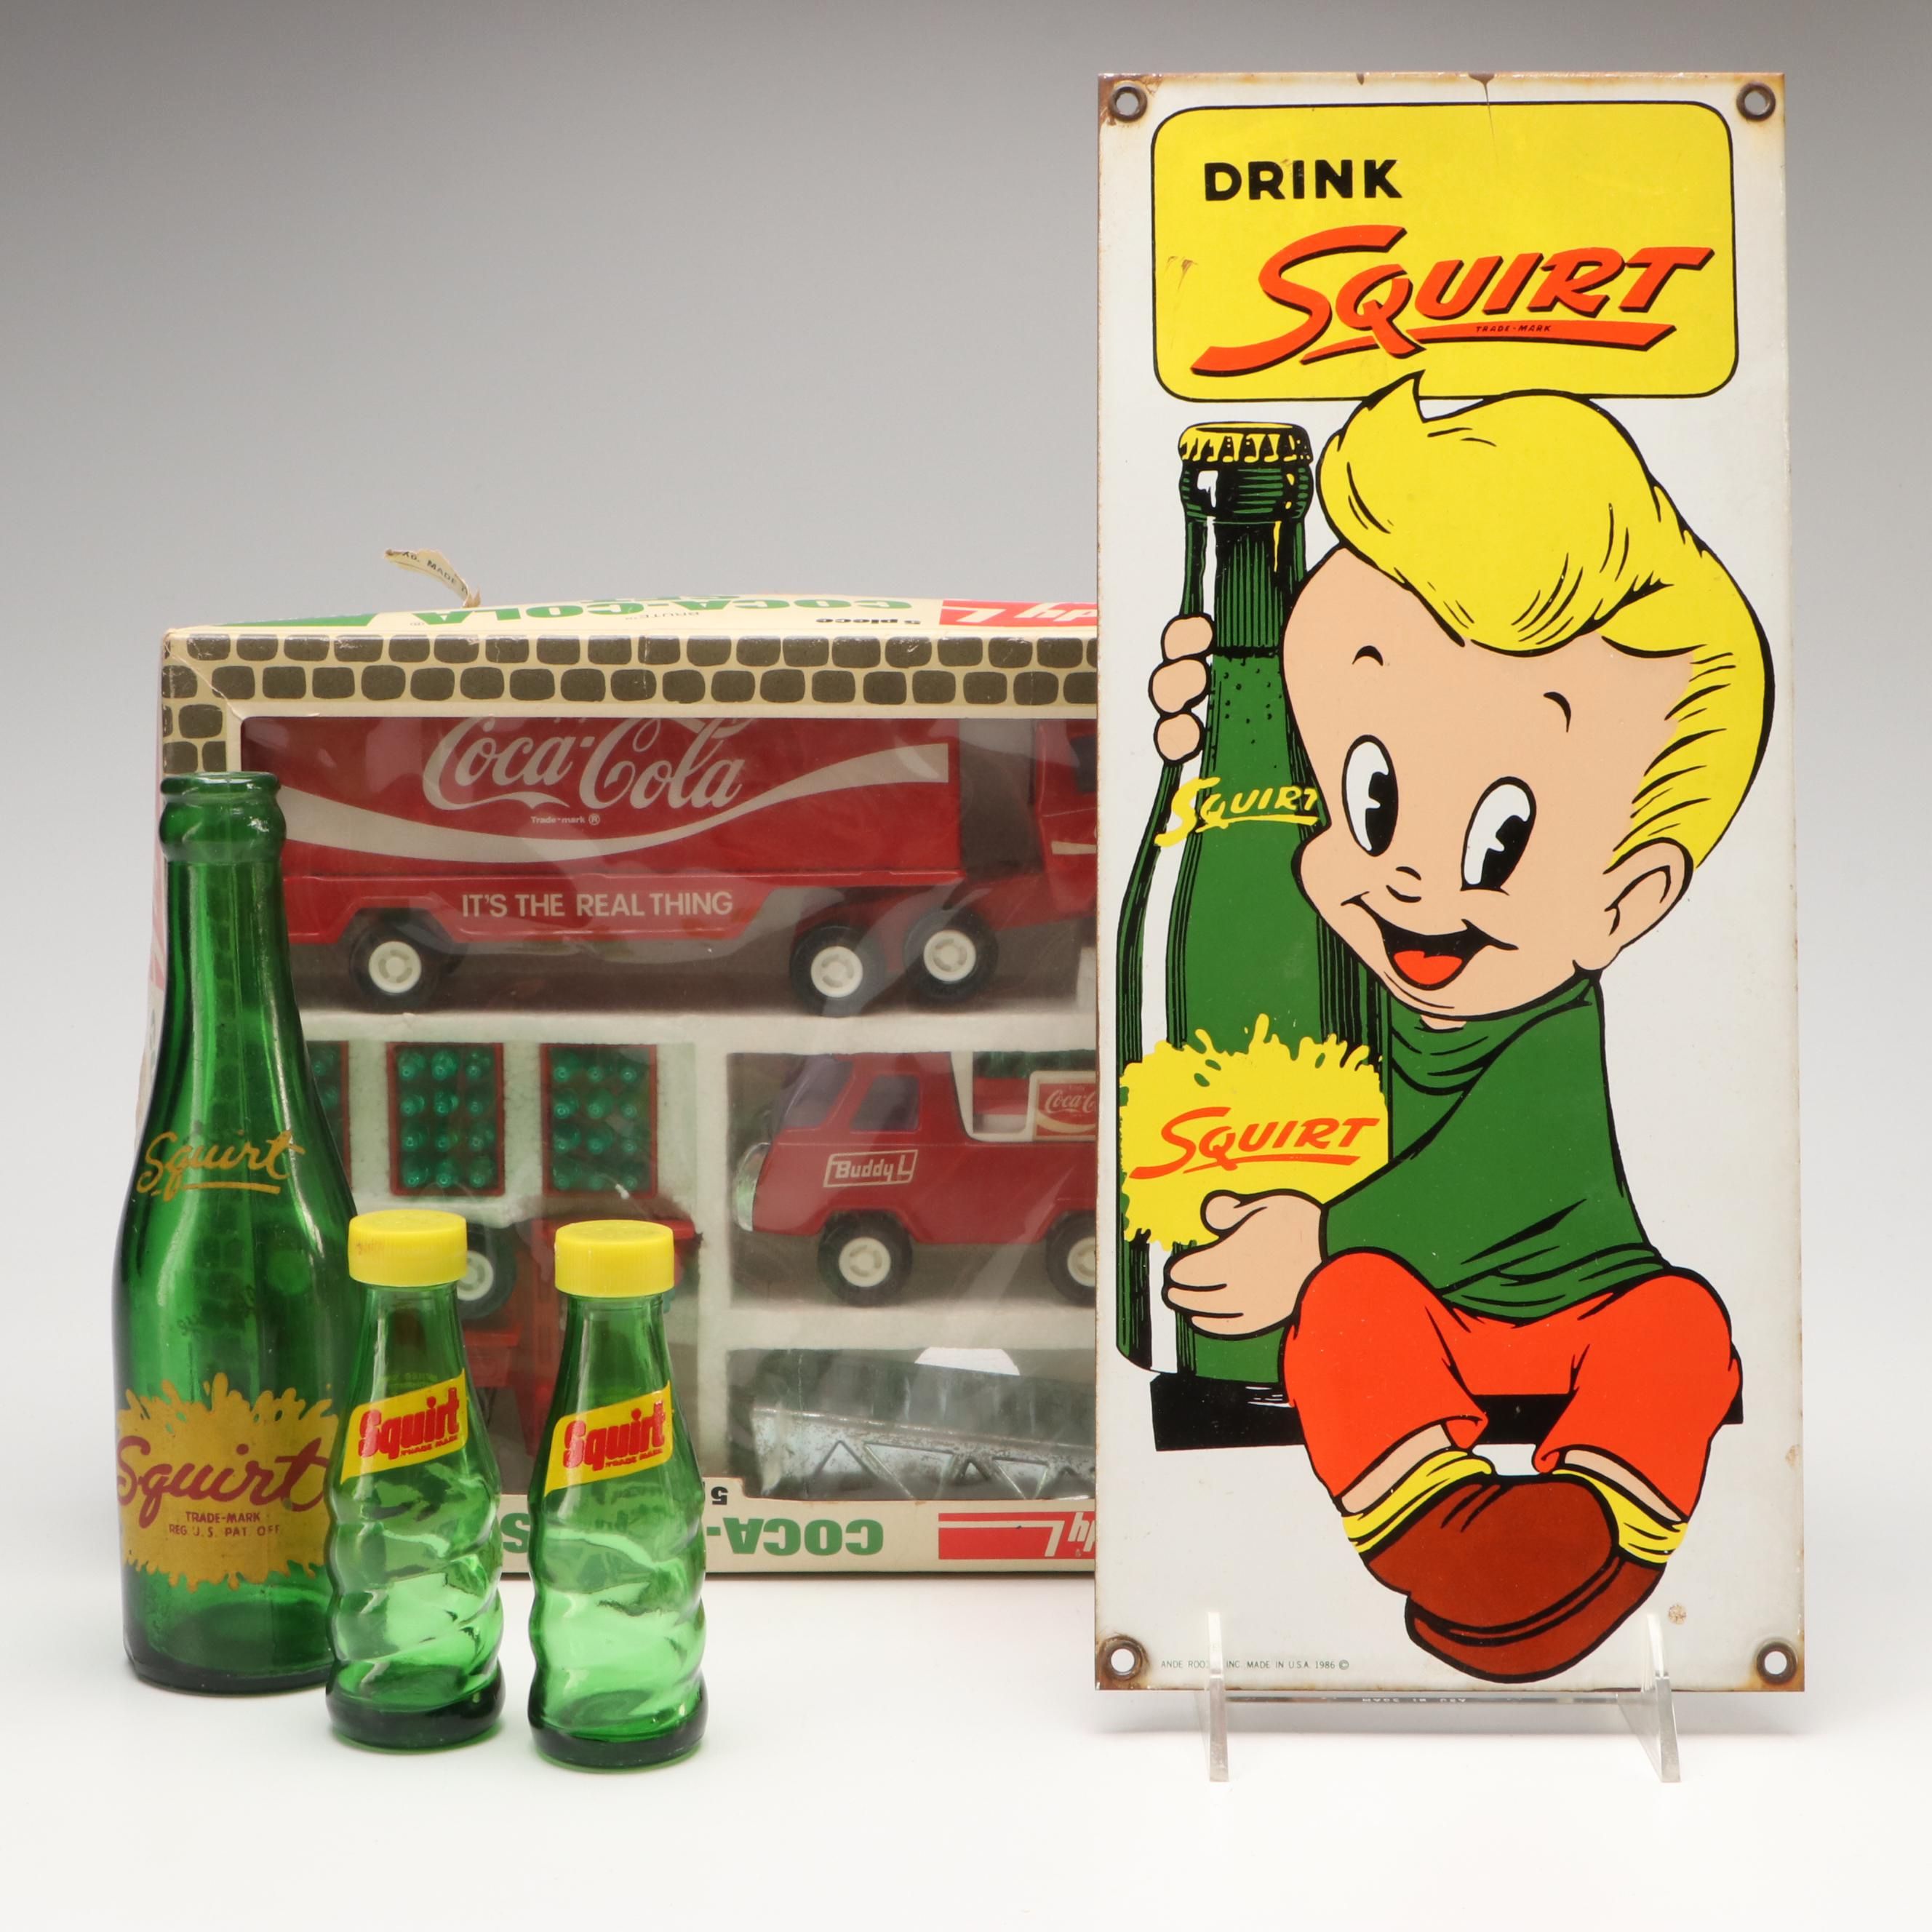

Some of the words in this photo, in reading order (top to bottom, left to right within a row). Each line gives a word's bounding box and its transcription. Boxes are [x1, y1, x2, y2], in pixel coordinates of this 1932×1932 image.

[1204, 159, 1402, 202] DRINK
[1190, 224, 1715, 378] SQUIRT
[412, 596, 913, 626] COCA-COLA
[422, 717, 754, 810] Coca-Cola
[1154, 776, 1319, 848] SQUIRT
[462, 893, 508, 918] IT'S
[515, 893, 565, 917] THE
[577, 893, 645, 917] REAL
[650, 891, 733, 917] THING
[1045, 1089, 1096, 1114] Coca-C
[1128, 1106, 1381, 1180] SQUIRT
[136, 1129, 306, 1202] Squirt
[834, 1159, 894, 1183] Buddy
[898, 1154, 911, 1175] L
[358, 1387, 460, 1460] Squirt
[562, 1399, 666, 1472] Squirt
[116, 1435, 330, 1529] Squirt
[711, 1486, 729, 1505] 5
[185, 1511, 260, 1523] TRADE-MARK
[706, 1517, 884, 1557] COCA-
[1246, 1661, 1269, 1669] MADE
[1275, 1661, 1285, 1669] IN
[1315, 1661, 1336, 1669] 1986
